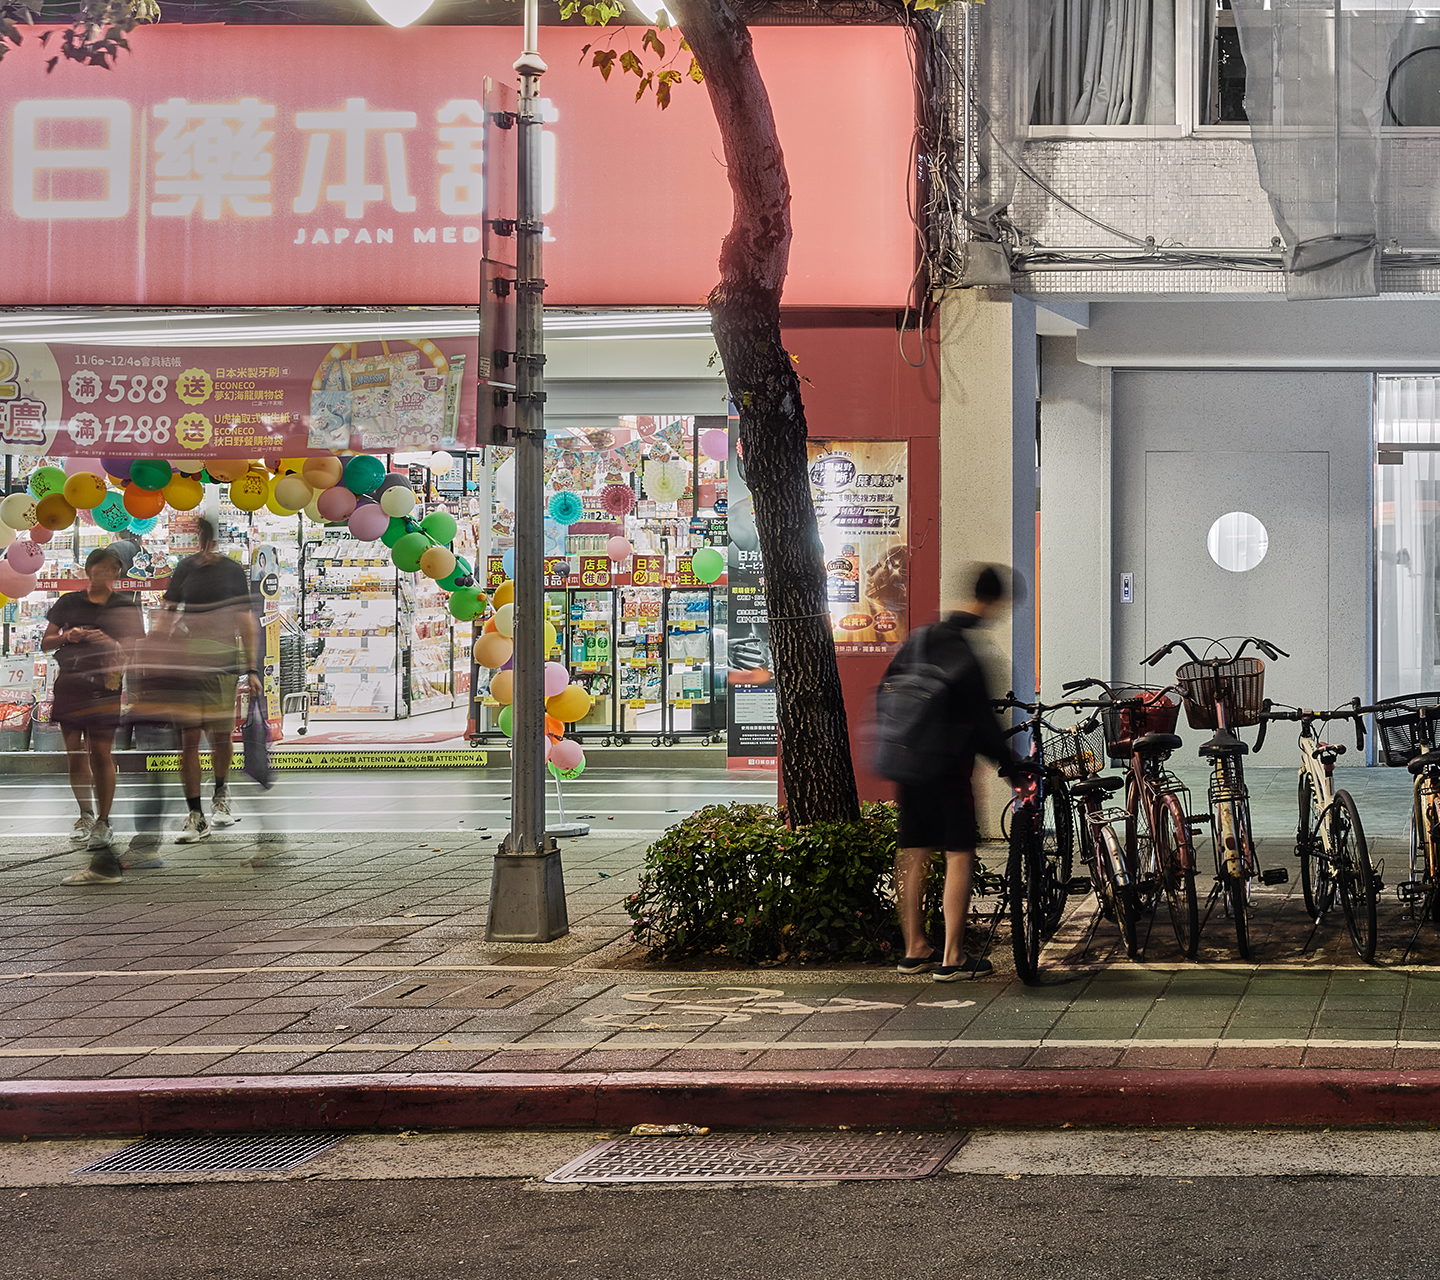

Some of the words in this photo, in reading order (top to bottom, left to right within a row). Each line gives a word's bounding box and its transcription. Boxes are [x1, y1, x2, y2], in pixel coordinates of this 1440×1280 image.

[295, 228, 394, 244] JAPAN
[414, 227, 556, 244] MEDL
[216, 367, 280, 378] 日本米製牙刷
[75, 377, 95, 397] 滿
[105, 375, 168, 403] 588
[183, 376, 205, 397] 送
[214, 382, 256, 390] ECONECO
[214, 390, 284, 400] 夢幻海龍購物袋
[75, 419, 95, 439] 滿
[104, 415, 171, 444] 1288
[183, 419, 205, 441] 送
[214, 427, 255, 436] ECONECO
[213, 436, 283, 446] 秋日野餐購物袋
[584, 559, 608, 570] 店長
[637, 559, 660, 570] 日本
[635, 571, 660, 584] 必買
[9, 670, 23, 682] 79
[1, 690, 27, 699] SALE
[159, 759, 180, 767] 小心台
[357, 756, 397, 764] ATTENTION
[406, 755, 434, 763] 小心台階
[435, 754, 474, 762] ATTENTION
